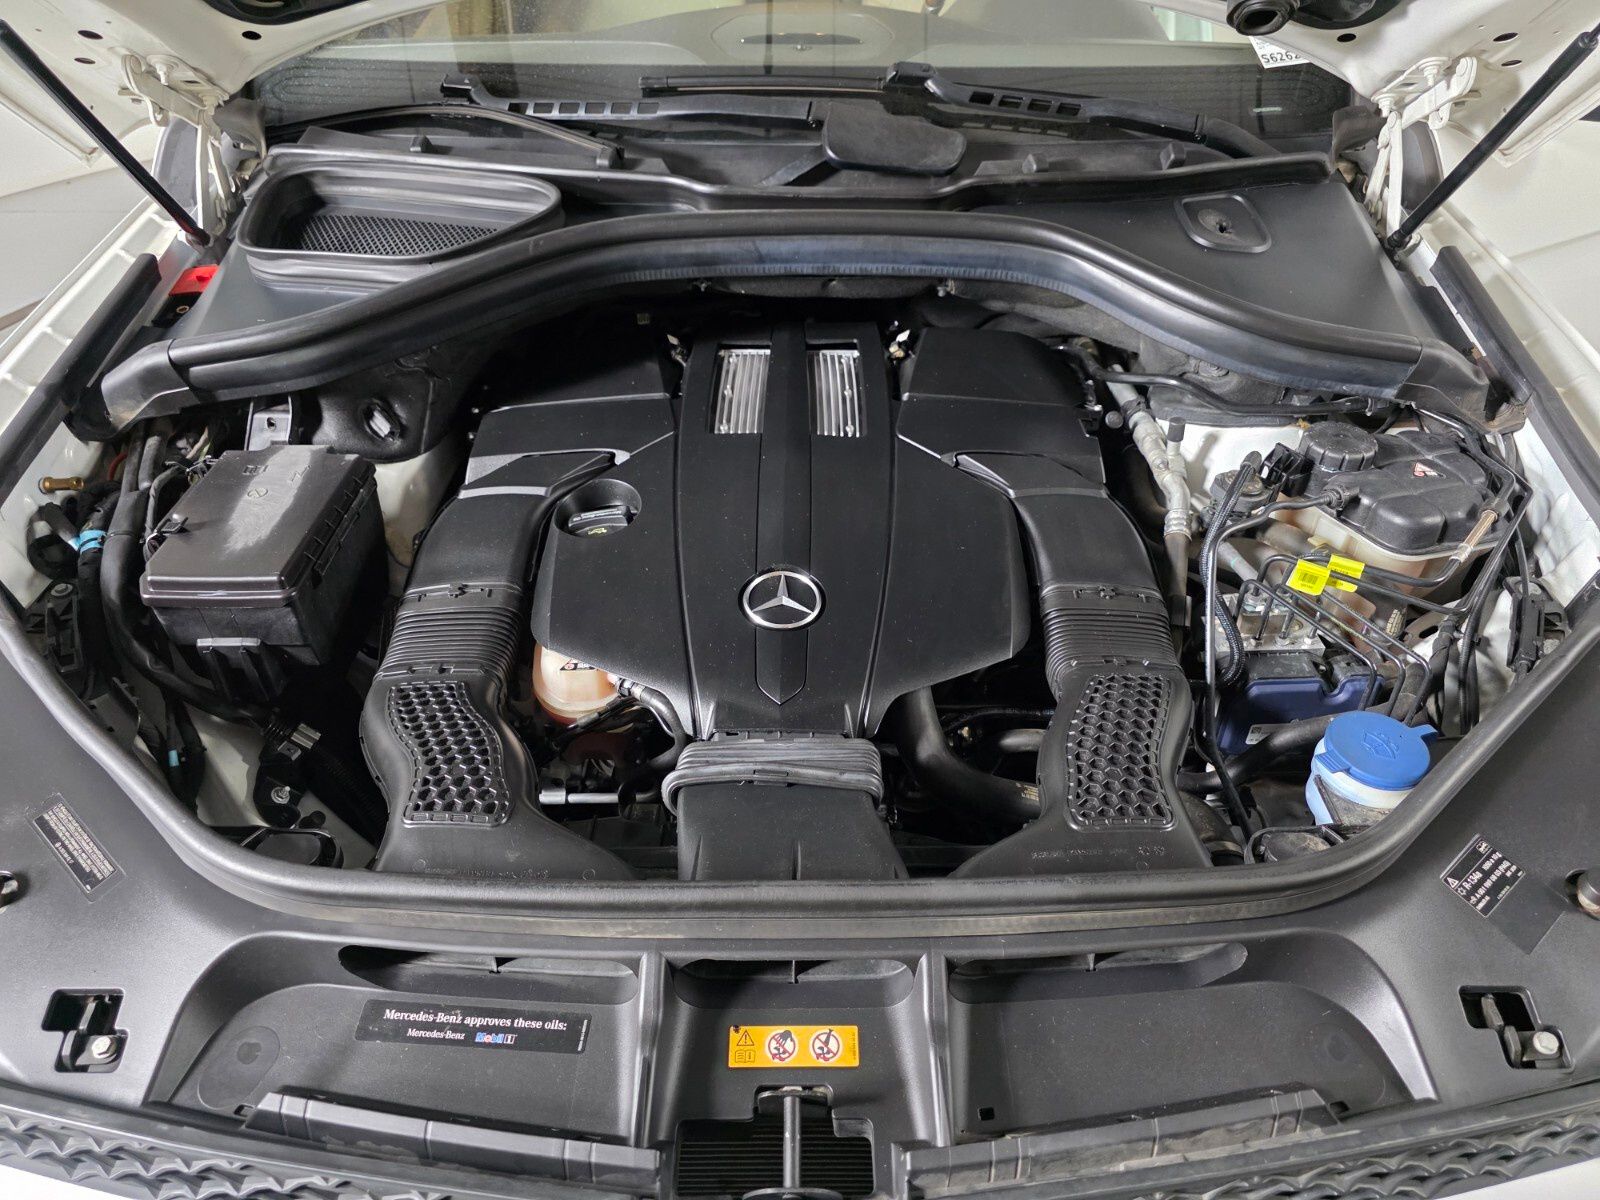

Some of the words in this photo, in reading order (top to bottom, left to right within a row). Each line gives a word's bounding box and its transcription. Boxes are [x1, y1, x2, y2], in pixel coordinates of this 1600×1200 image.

[383, 1009, 462, 1023] Mercedes-Benz
[464, 1016, 511, 1028] approves
[514, 1017, 543, 1029] these
[545, 1019, 568, 1031] oils:
[407, 1028, 465, 1040] Mercedes-Benz
